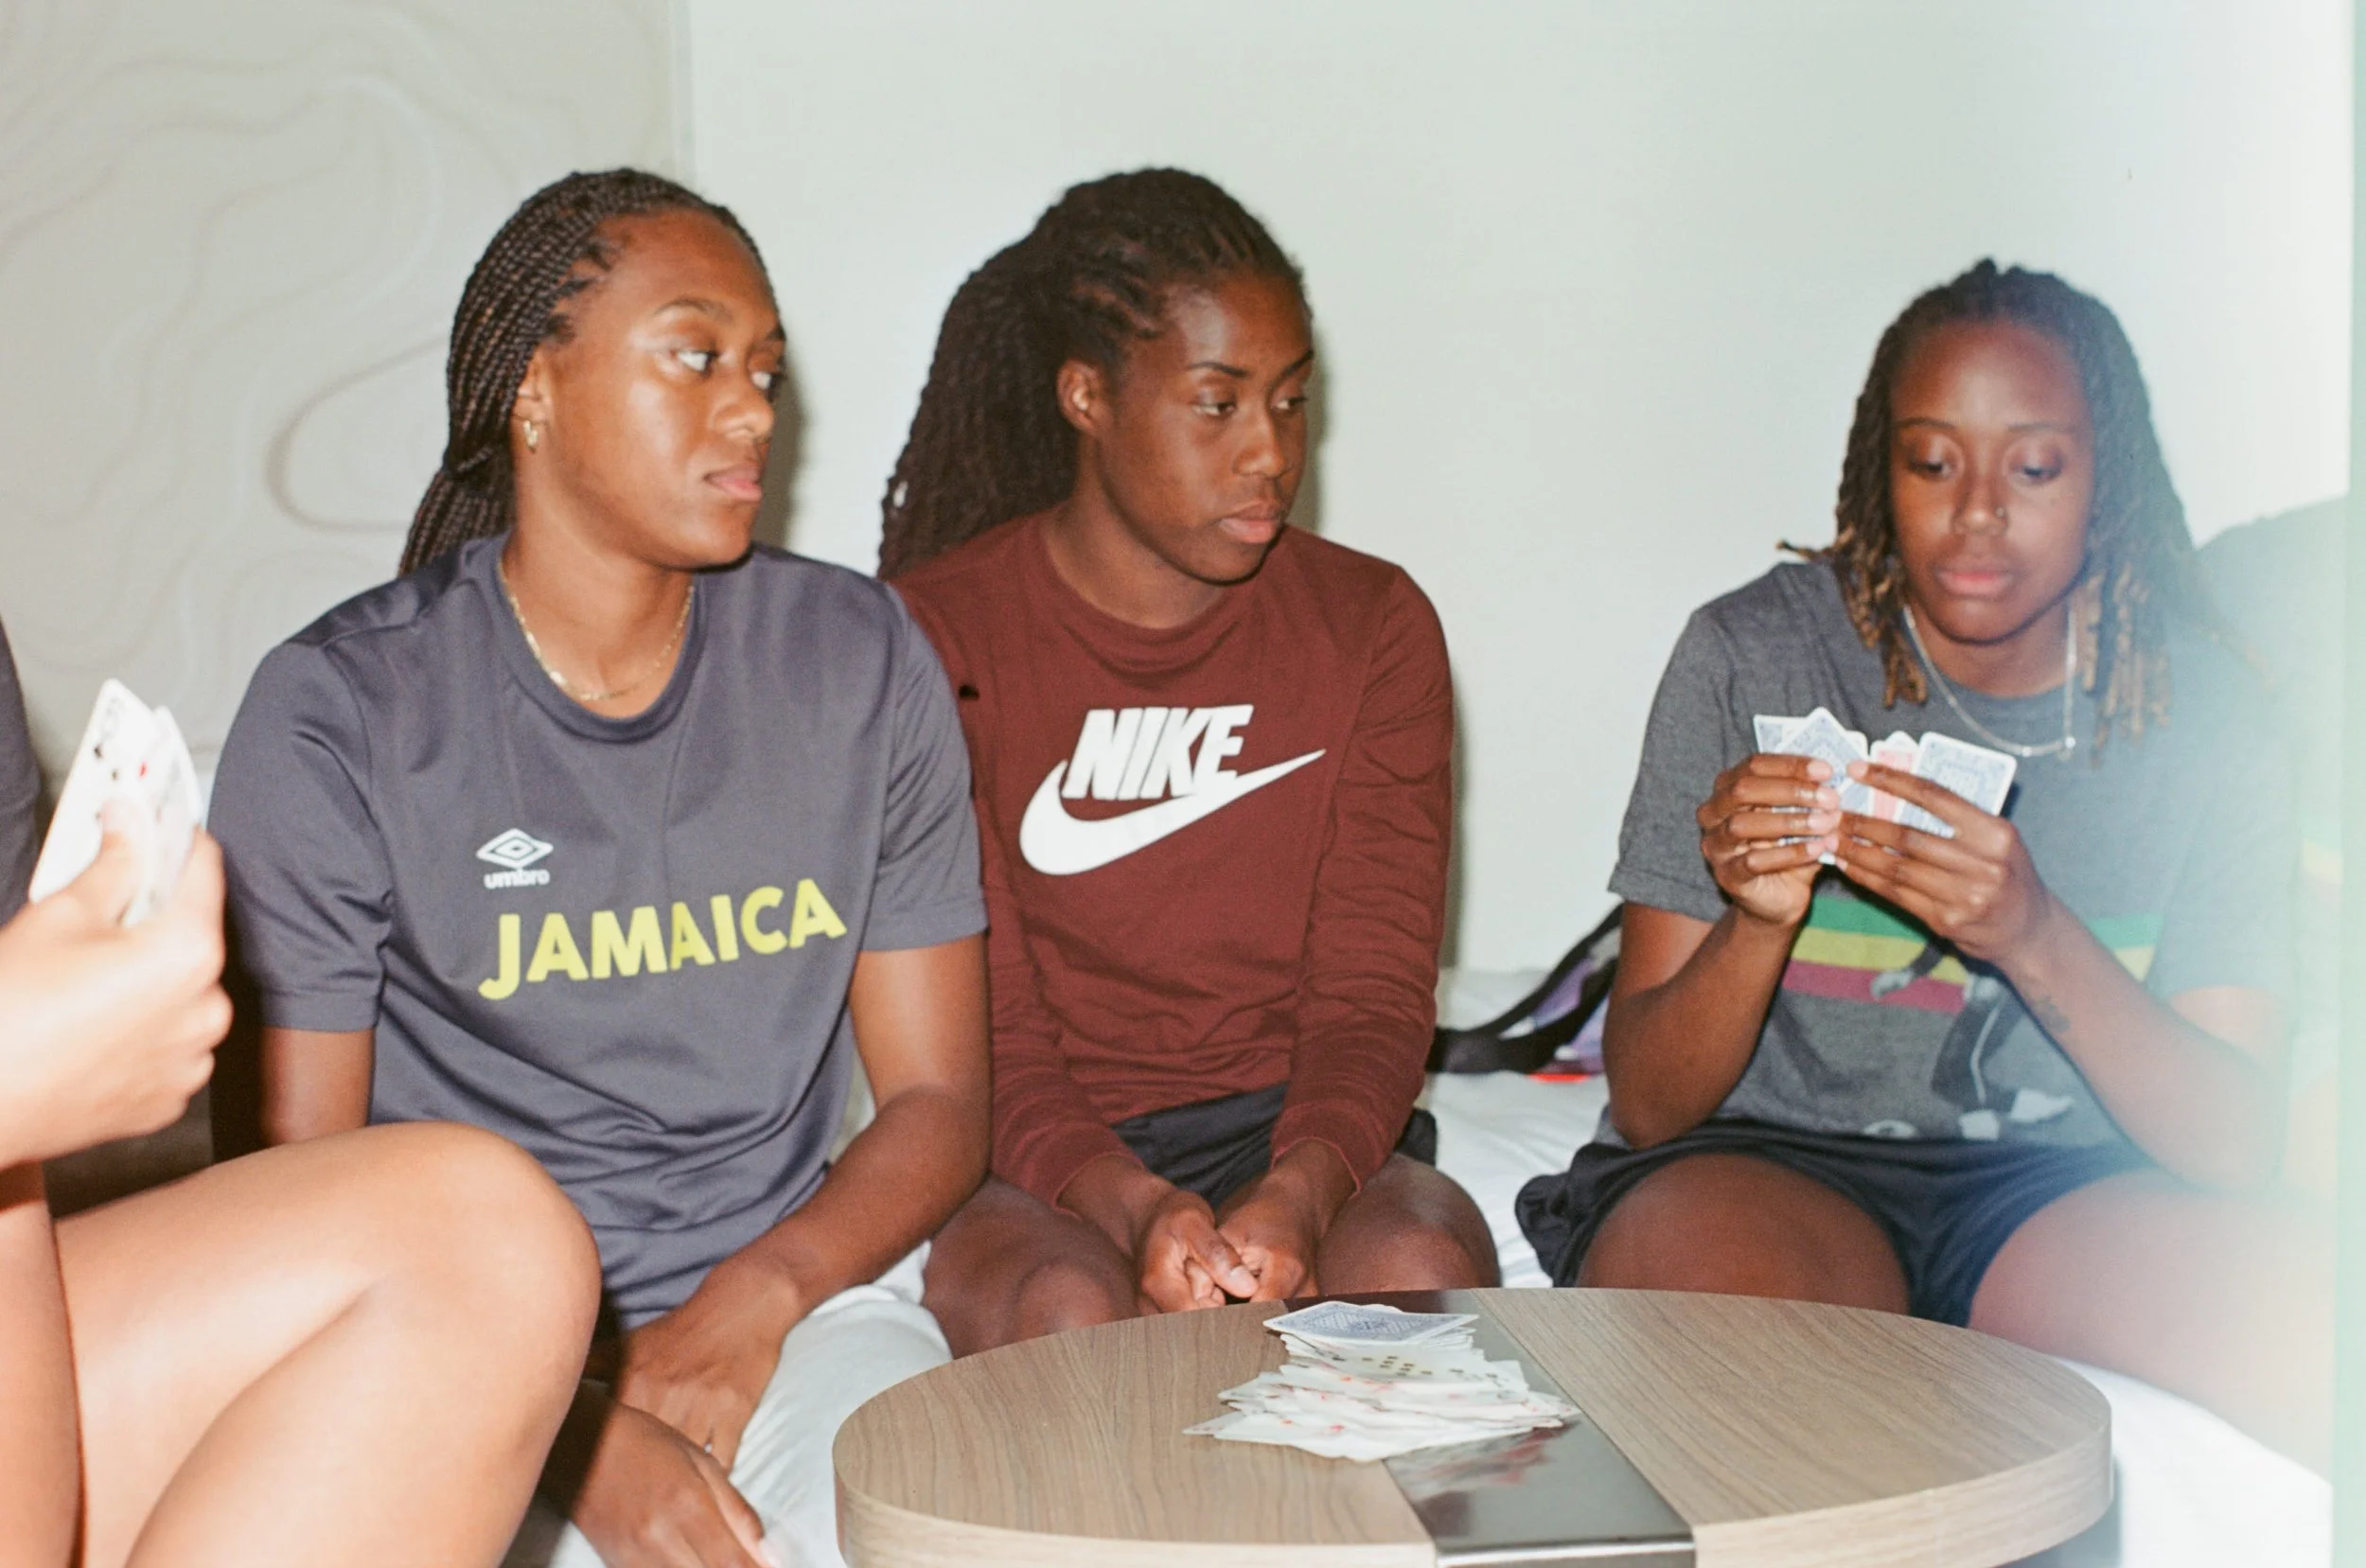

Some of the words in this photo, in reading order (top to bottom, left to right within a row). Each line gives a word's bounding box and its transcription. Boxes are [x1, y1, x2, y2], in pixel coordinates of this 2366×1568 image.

[1062, 704, 1254, 800] NIKE
[484, 867, 550, 889] umbro
[478, 878, 847, 1000] JAMAICA
